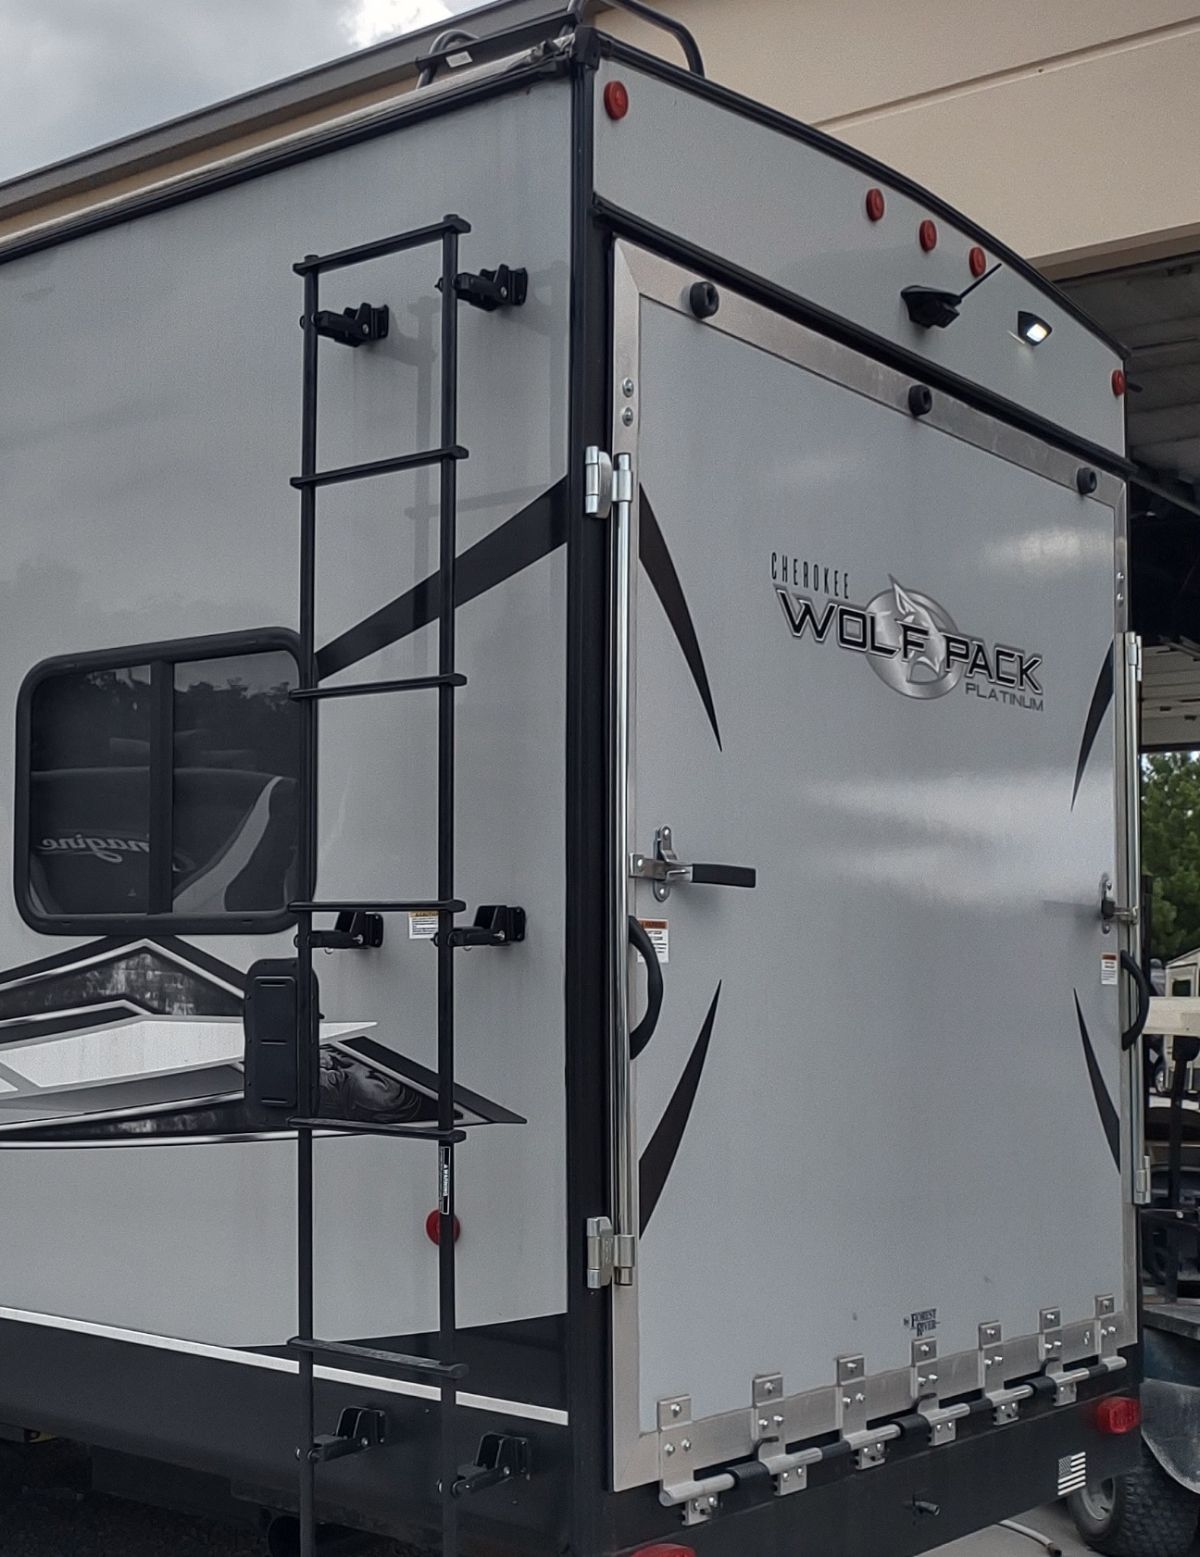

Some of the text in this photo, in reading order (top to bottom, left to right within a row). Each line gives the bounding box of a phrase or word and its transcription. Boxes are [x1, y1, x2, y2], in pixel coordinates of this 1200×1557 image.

[771, 552, 849, 599] CHEROKEE
[773, 584, 1043, 695] WOLF PACK
[965, 682, 1044, 711] PLATINUM
